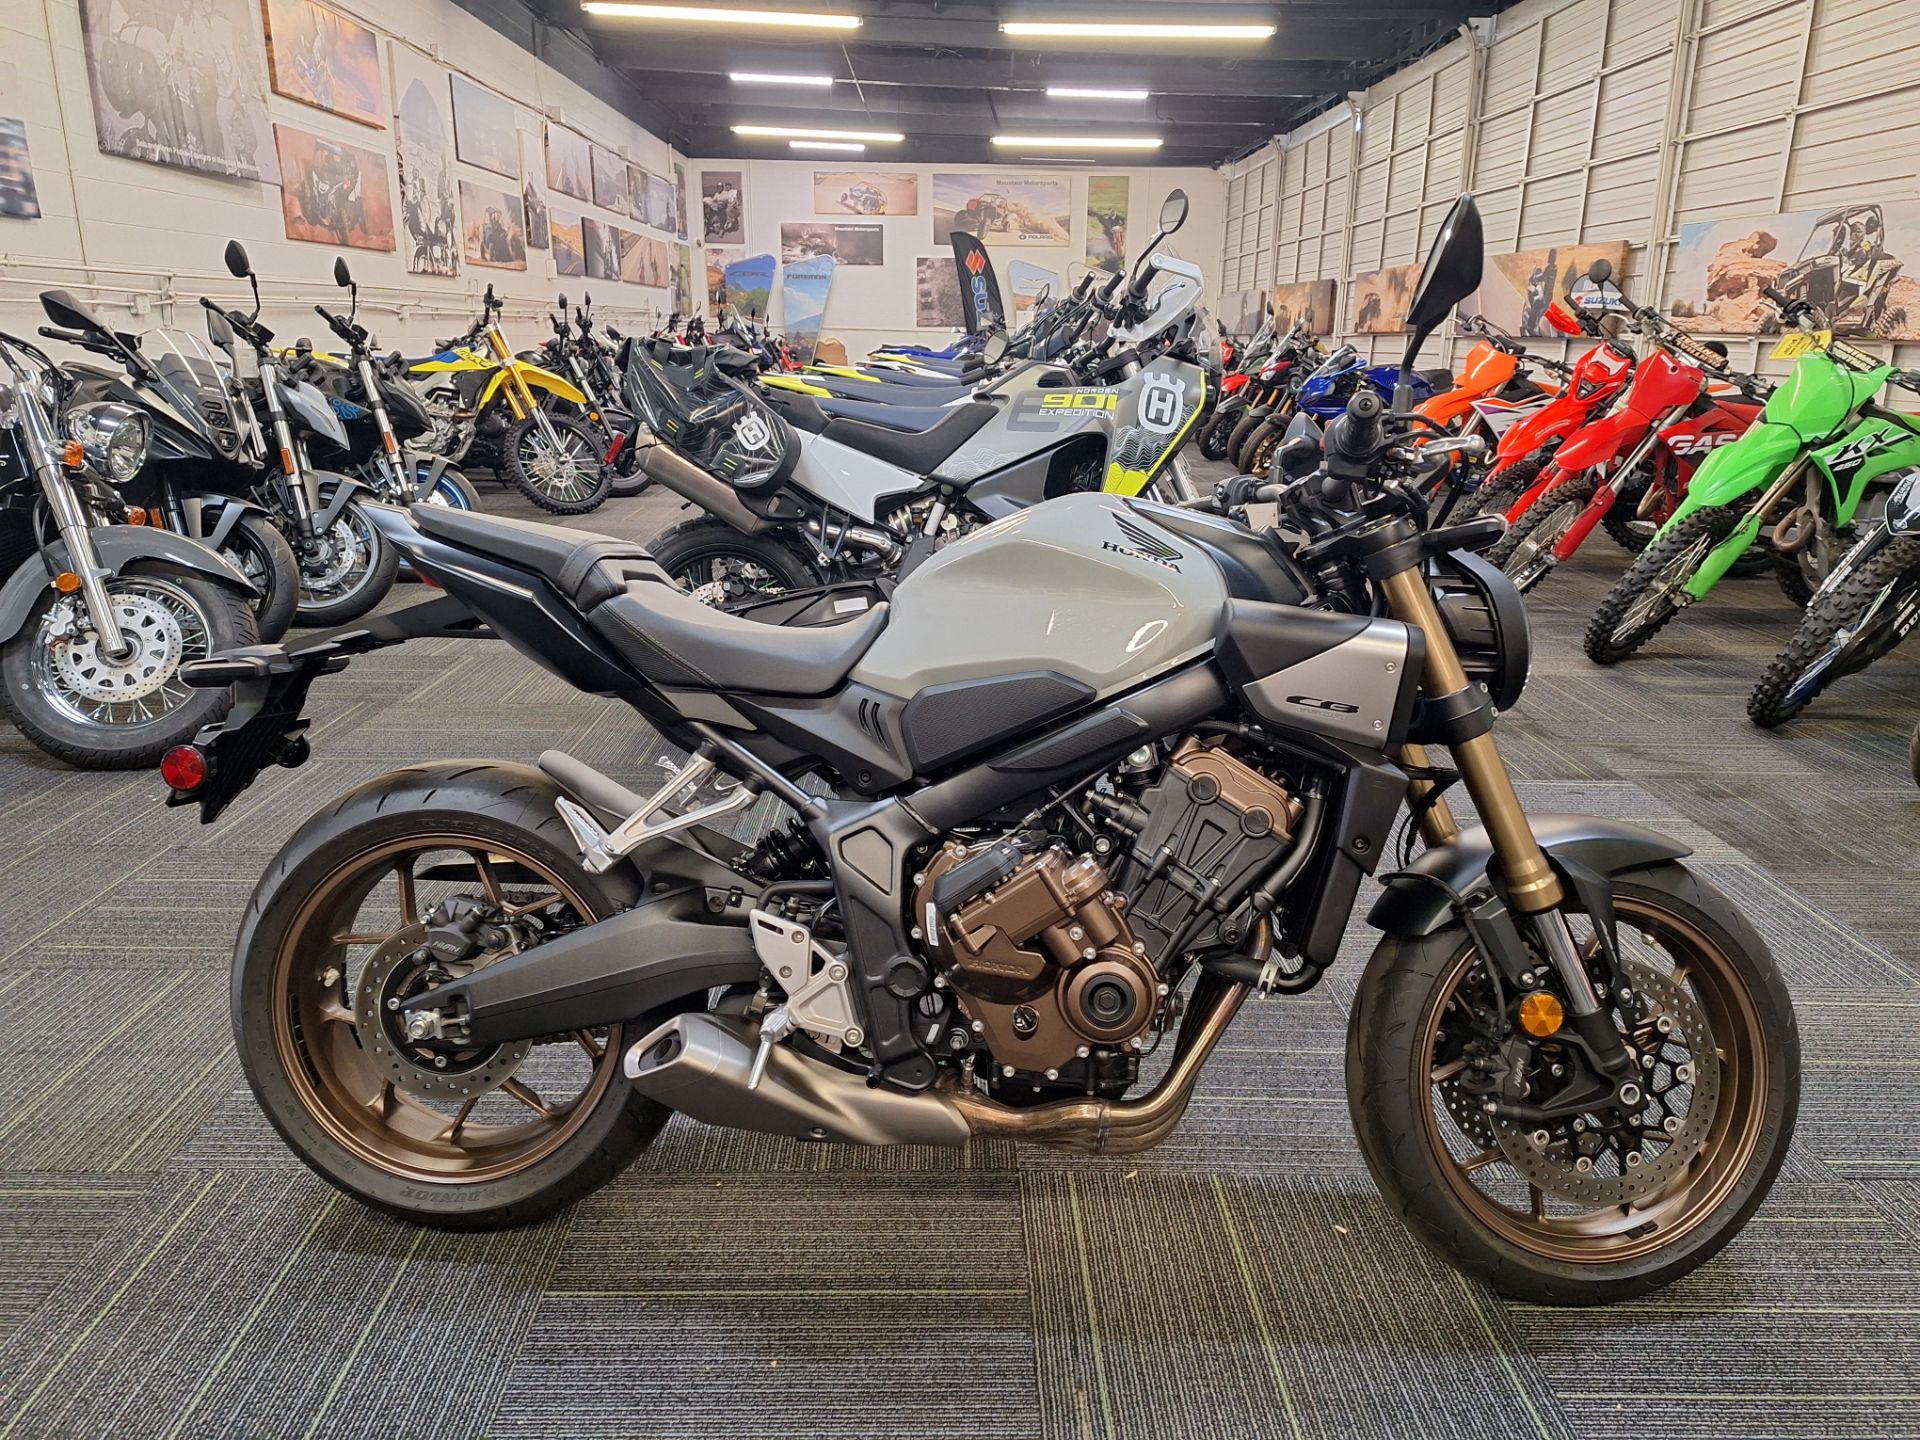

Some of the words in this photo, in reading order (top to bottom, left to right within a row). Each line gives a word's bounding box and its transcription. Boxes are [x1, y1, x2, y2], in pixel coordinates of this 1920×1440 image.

[1038, 408, 1115, 420] EXPEDITION
[1832, 426, 1895, 462] KX
[1101, 540, 1183, 575] HONDA
[1286, 696, 1360, 713] CB
[968, 958, 1031, 978] HONDA
